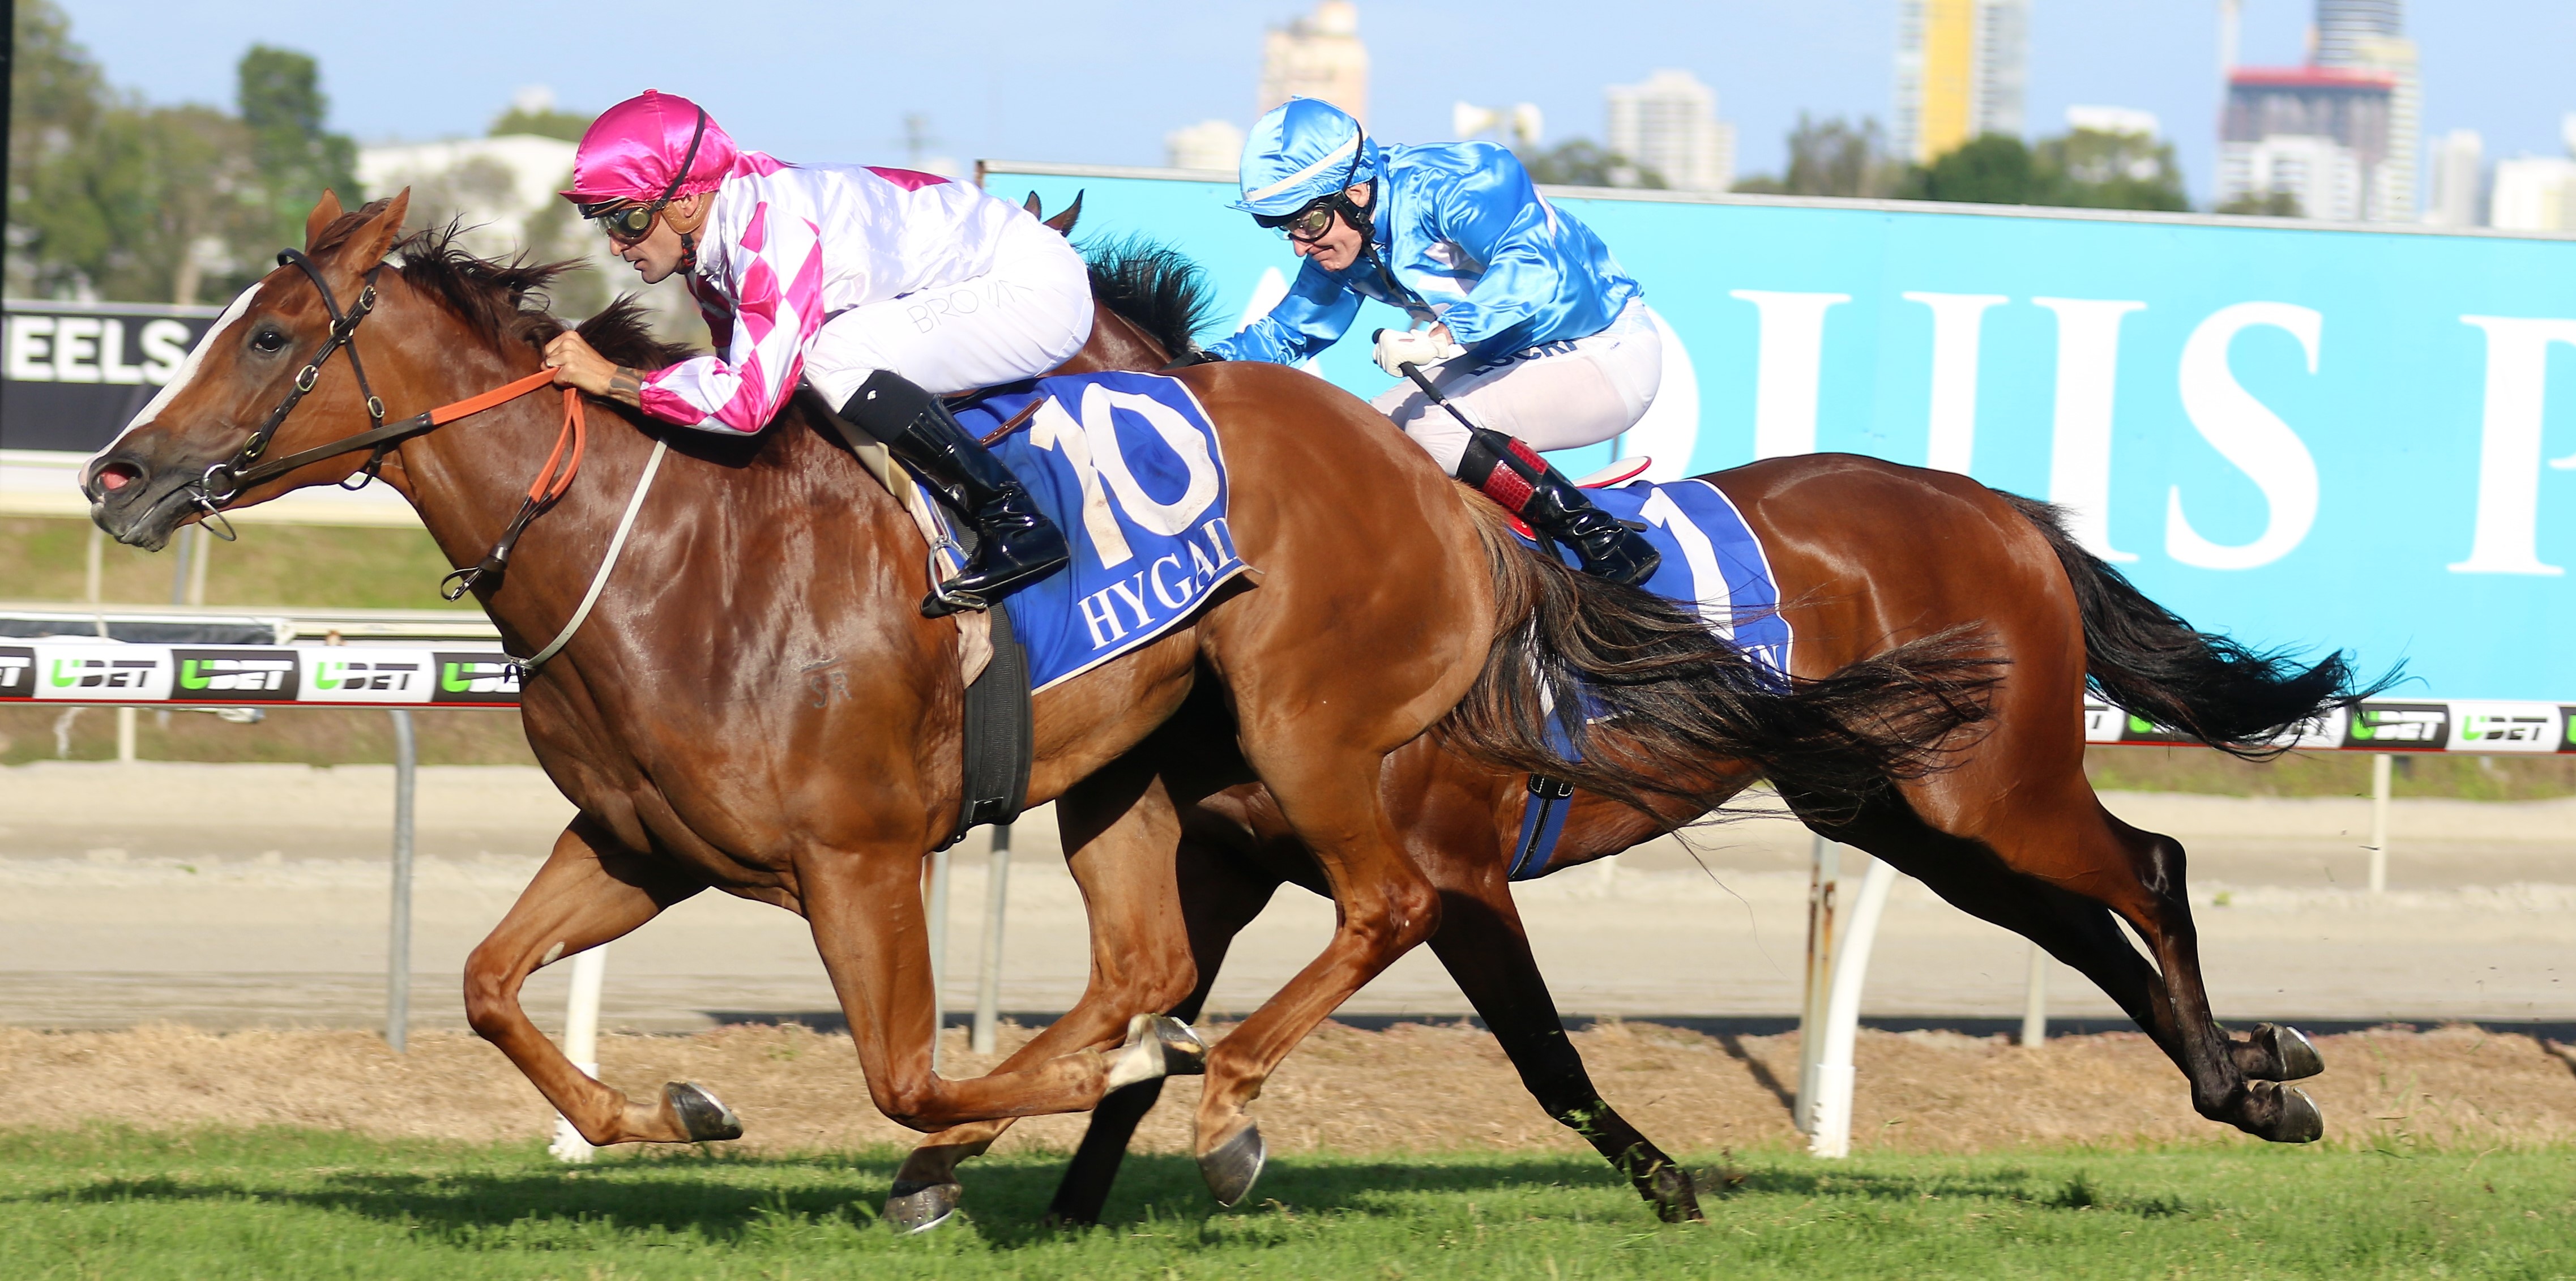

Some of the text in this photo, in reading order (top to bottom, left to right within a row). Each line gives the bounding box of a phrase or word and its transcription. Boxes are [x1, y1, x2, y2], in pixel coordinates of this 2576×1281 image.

[2, 315, 191, 386] EELS
[1029, 382, 1219, 570] 10
[1638, 486, 1736, 640] 1
[52, 659, 157, 688] UBET
[181, 659, 293, 690] UBET
[315, 661, 419, 690] UBET
[441, 662, 520, 693] UBE
[2350, 710, 2445, 741] UBET
[2461, 715, 2548, 741] UBET
